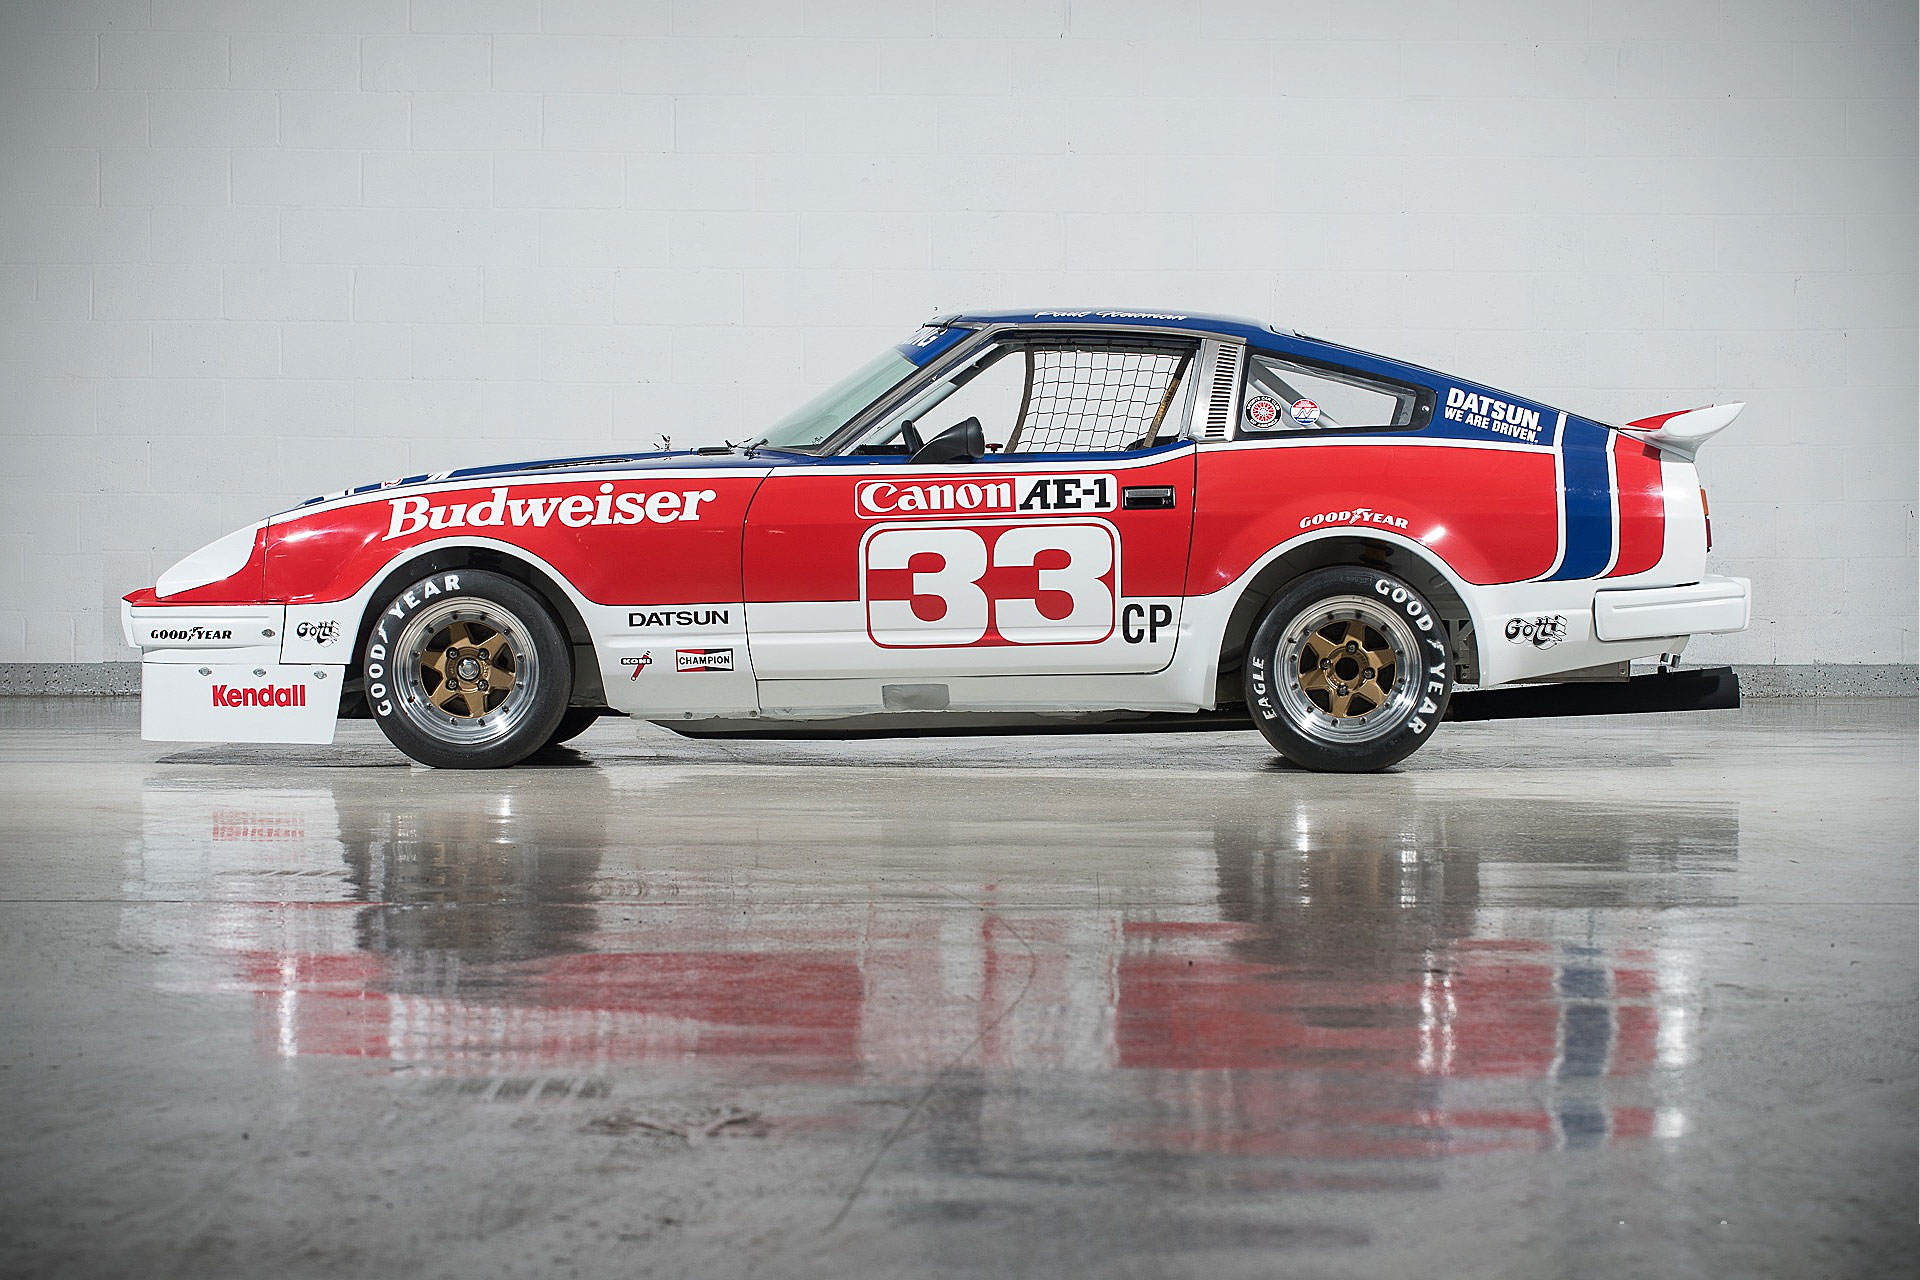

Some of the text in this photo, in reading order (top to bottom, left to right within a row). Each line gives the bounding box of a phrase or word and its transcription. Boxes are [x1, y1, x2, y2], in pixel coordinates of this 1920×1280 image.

[1444, 406, 1464, 422] WE
[1464, 412, 1490, 430] ARE
[1446, 386, 1543, 432] DATSUN.
[381, 482, 717, 542] Budweiser
[860, 477, 1111, 513] Canon AE-1
[868, 525, 1114, 645] 33
[628, 610, 729, 627] DATSUN
[1122, 603, 1173, 644] CP
[621, 657, 652, 665] KONI
[679, 654, 731, 666] CHAMPION
[212, 683, 306, 708] Kendall
[1252, 655, 1278, 721] EAGLE
